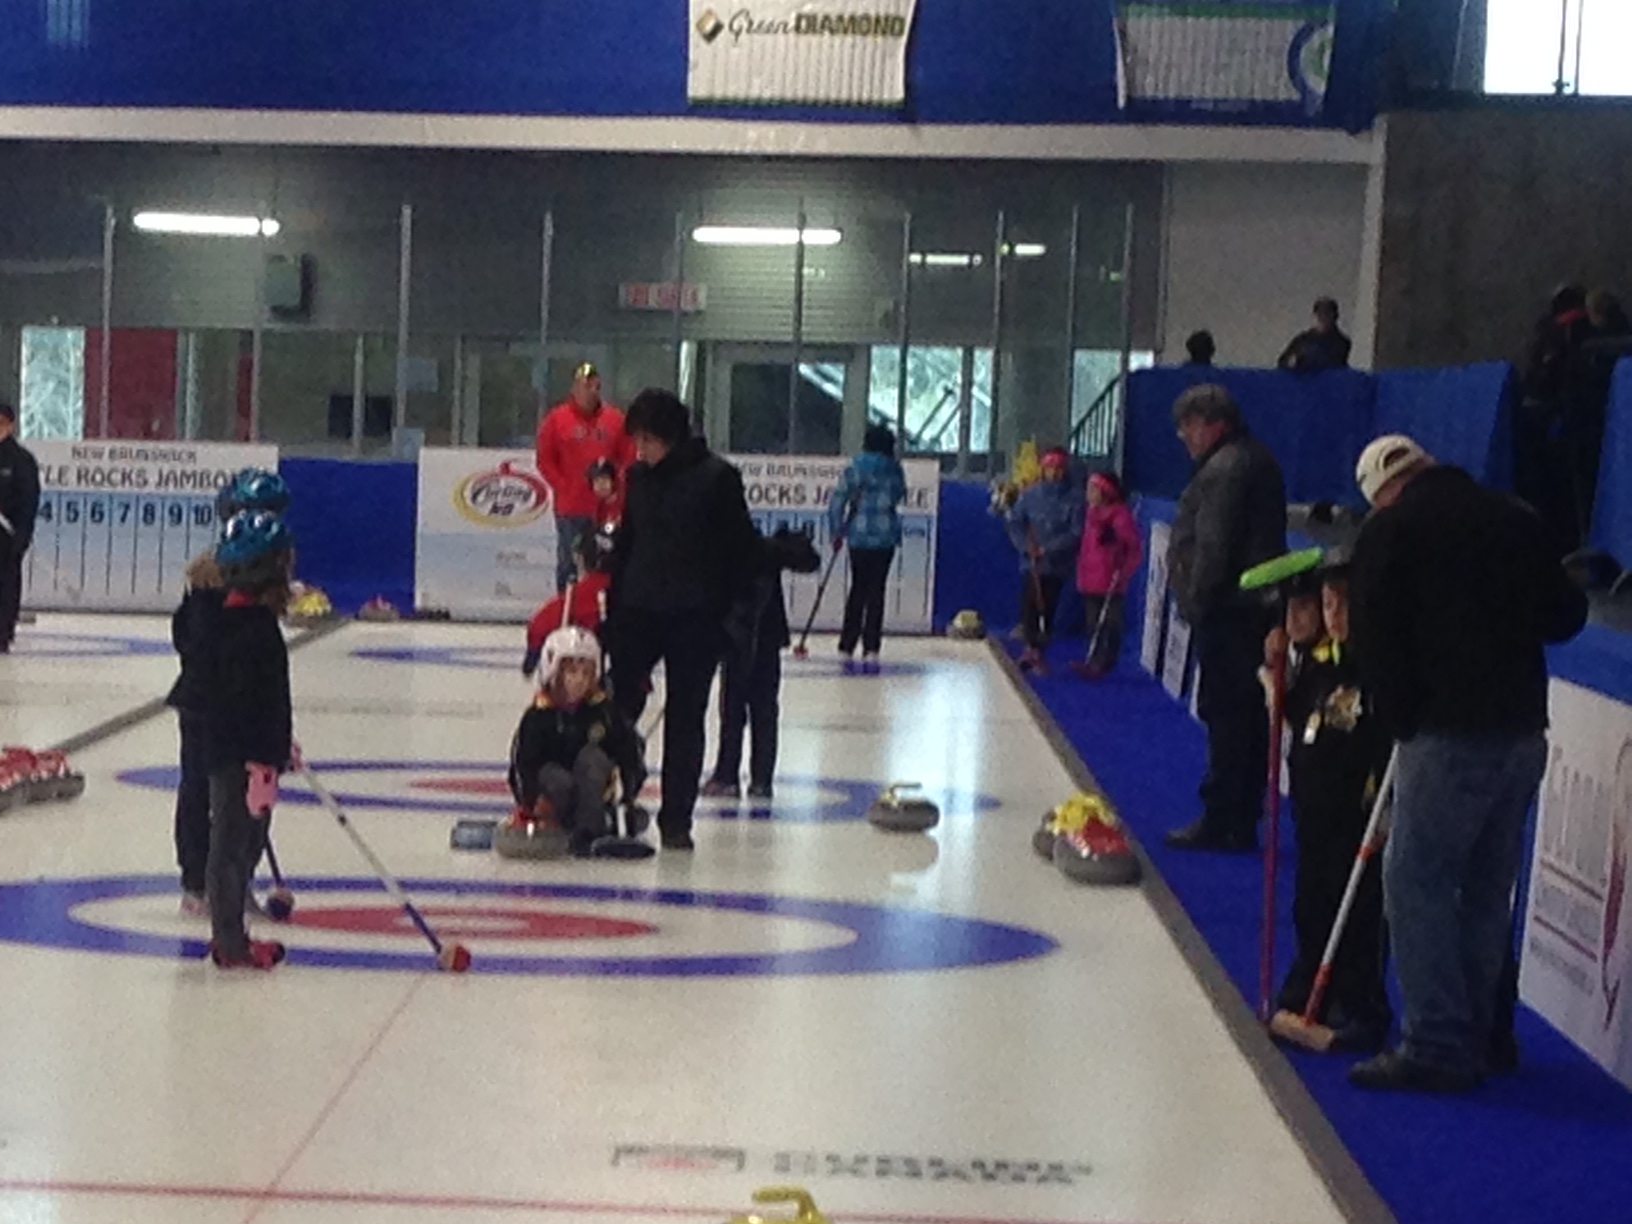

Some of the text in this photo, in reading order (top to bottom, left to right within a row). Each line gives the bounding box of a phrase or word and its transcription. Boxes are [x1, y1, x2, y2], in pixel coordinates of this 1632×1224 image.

[76, 466, 148, 489] ROCKS
[154, 468, 230, 491] JAMBO
[748, 483, 807, 505] OCKS
[66, 501, 80, 523] 5
[90, 502, 105, 524] 6
[118, 502, 131, 524] 7
[143, 502, 156, 525] 8
[168, 504, 183, 526] 9
[194, 505, 212, 526] 10
